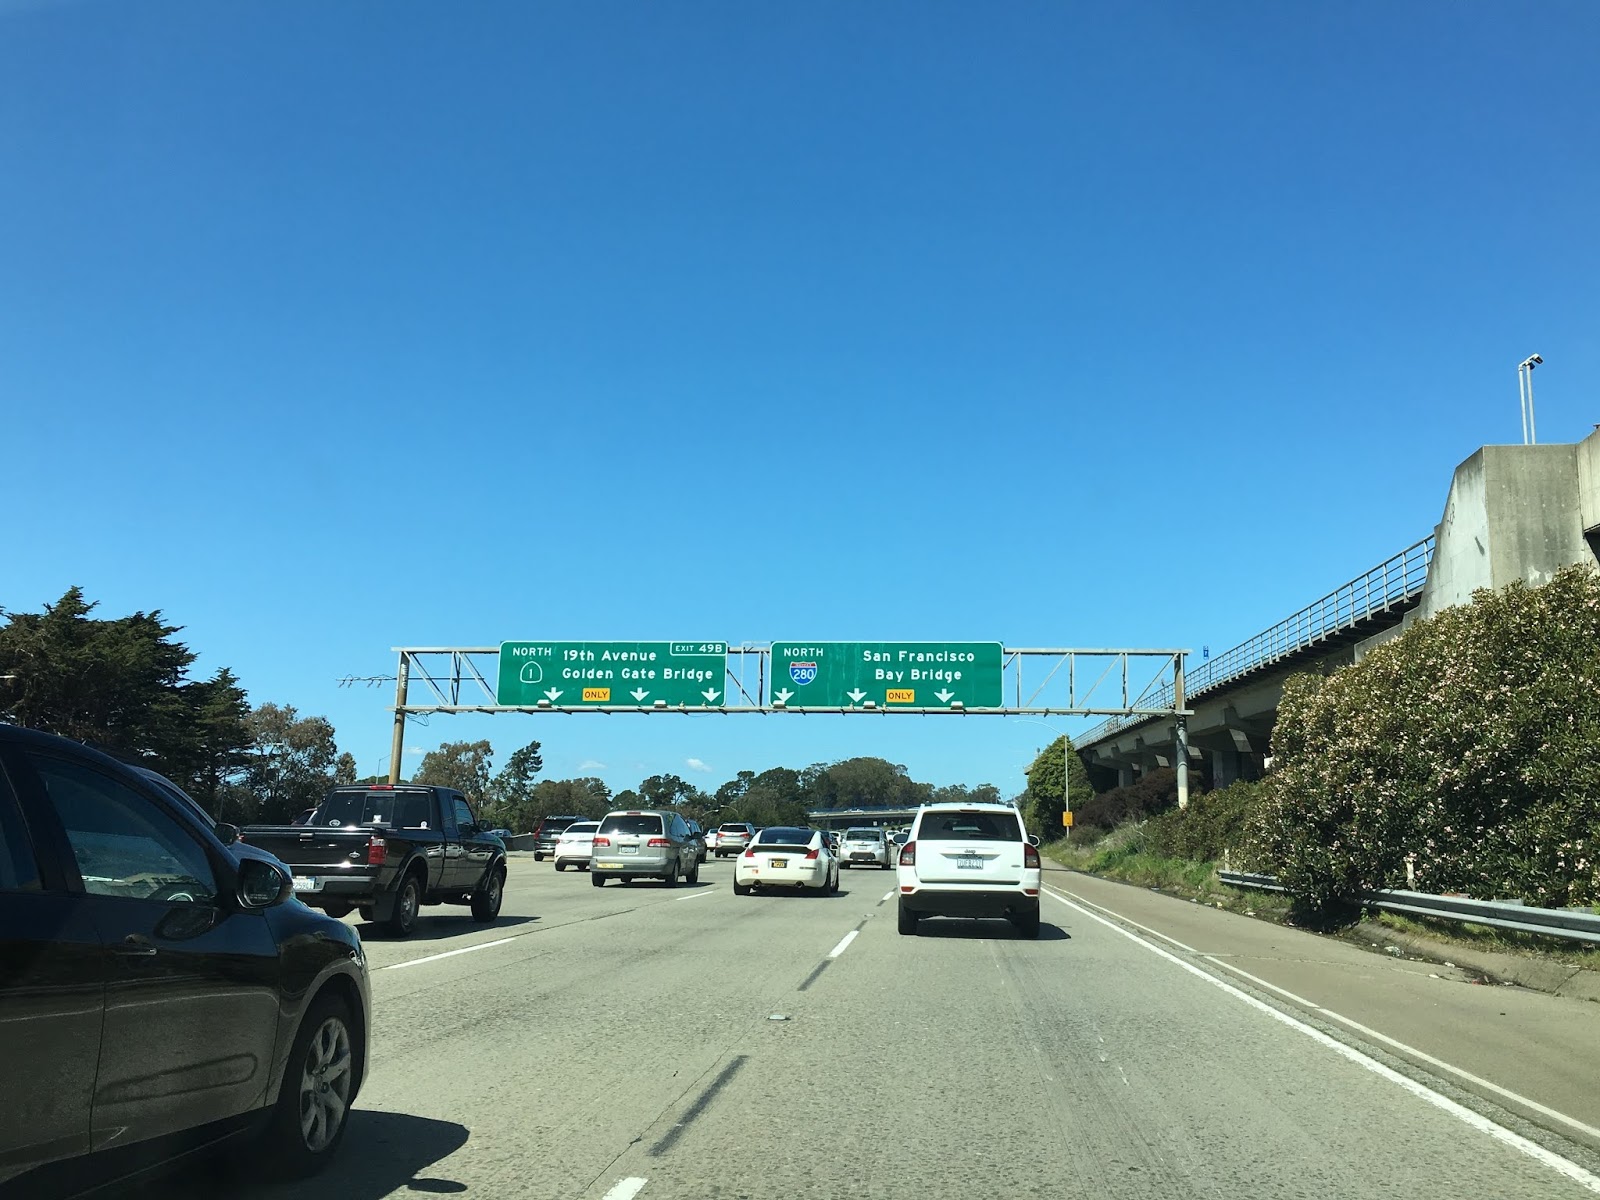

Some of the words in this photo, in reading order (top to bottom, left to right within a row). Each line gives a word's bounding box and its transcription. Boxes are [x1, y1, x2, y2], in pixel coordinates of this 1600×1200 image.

[512, 647, 552, 657] NORTH
[698, 644, 722, 653] 49B
[783, 648, 824, 657] NORTH
[563, 649, 594, 661] 19th
[601, 650, 657, 661] Avenue
[863, 651, 890, 662] San
[898, 650, 975, 662] Francisco
[528, 669, 533, 679] 1
[562, 668, 613, 679] Golden
[621, 668, 656, 680] Gate
[663, 668, 713, 682] Bridge
[793, 669, 815, 680] 280
[875, 669, 904, 682] Bay
[911, 669, 962, 683] Bridge
[584, 690, 608, 699] ONLY
[888, 691, 912, 700] ONLY
